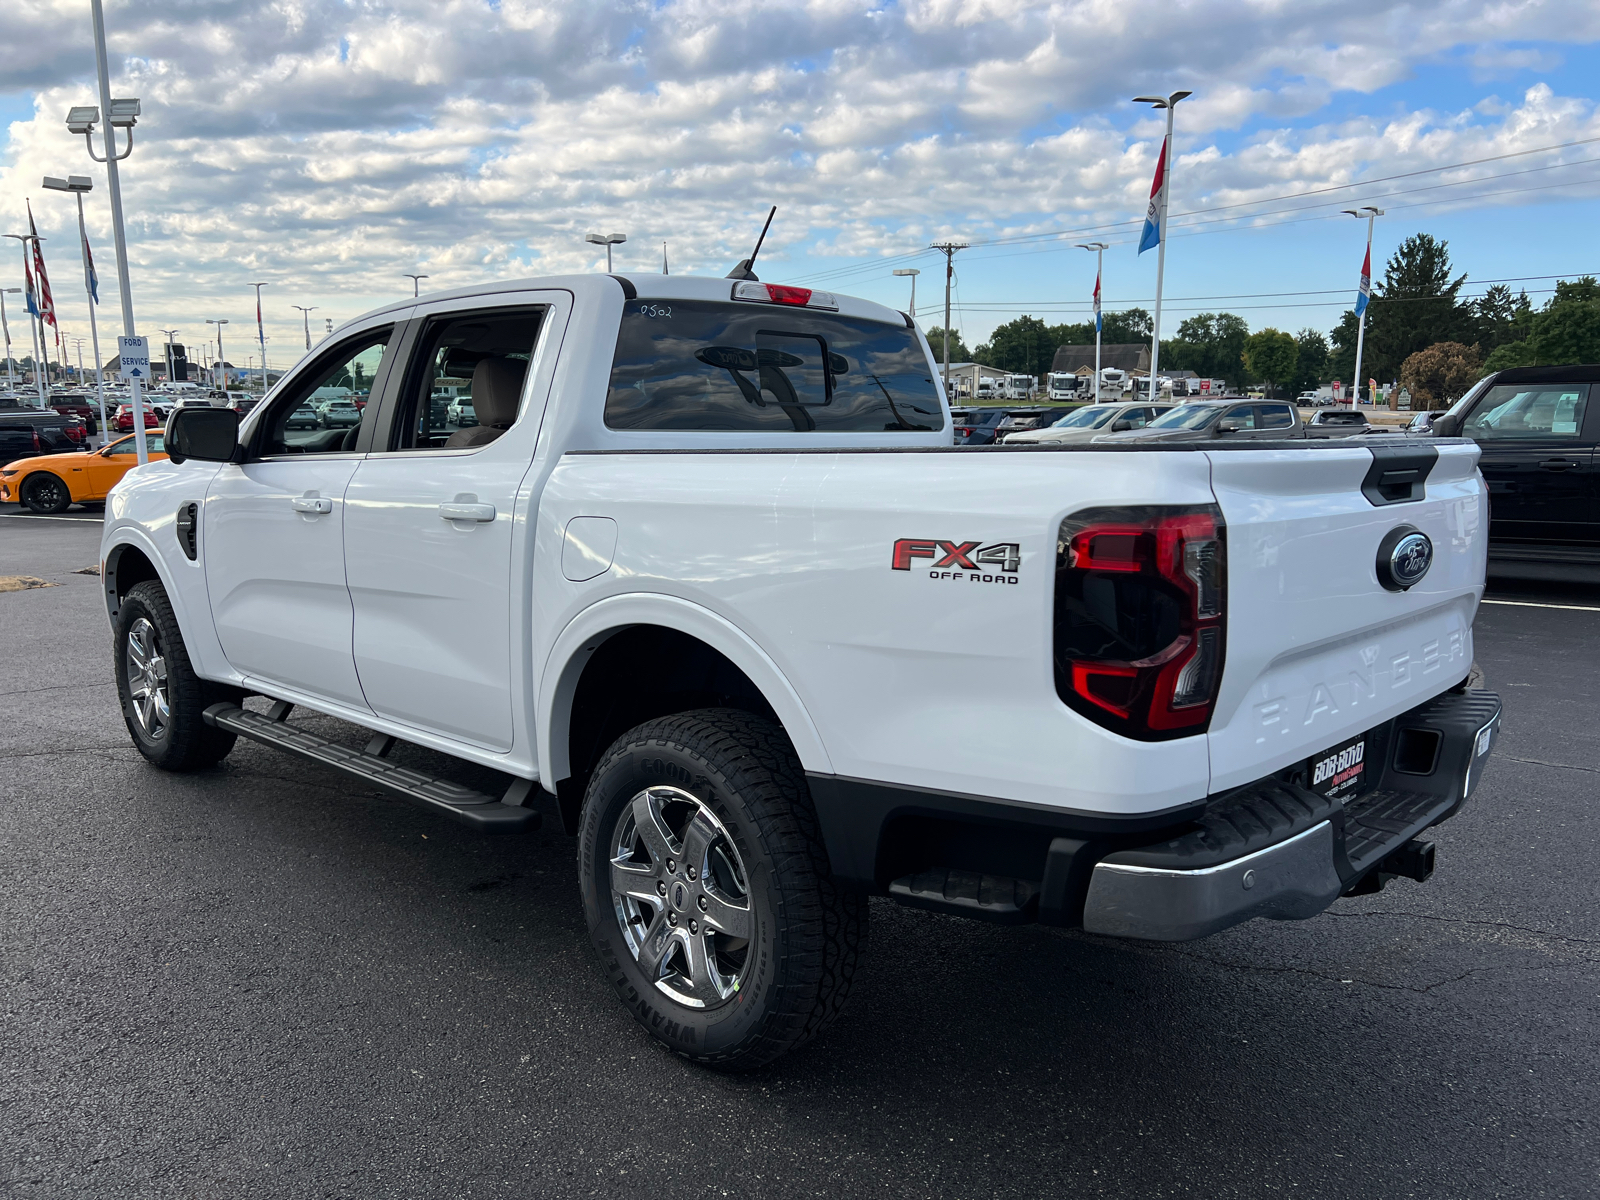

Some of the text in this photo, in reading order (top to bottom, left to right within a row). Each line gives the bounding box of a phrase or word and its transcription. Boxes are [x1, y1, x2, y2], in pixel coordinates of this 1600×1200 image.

[640, 304, 672, 319] 0502
[124, 338, 142, 346] FORD
[121, 357, 148, 366] SERVICE
[891, 538, 1021, 573] FX4
[929, 571, 1019, 585] OFF ROAD
[1252, 630, 1464, 744] RANGER
[597, 937, 699, 1046] WRANGLER
